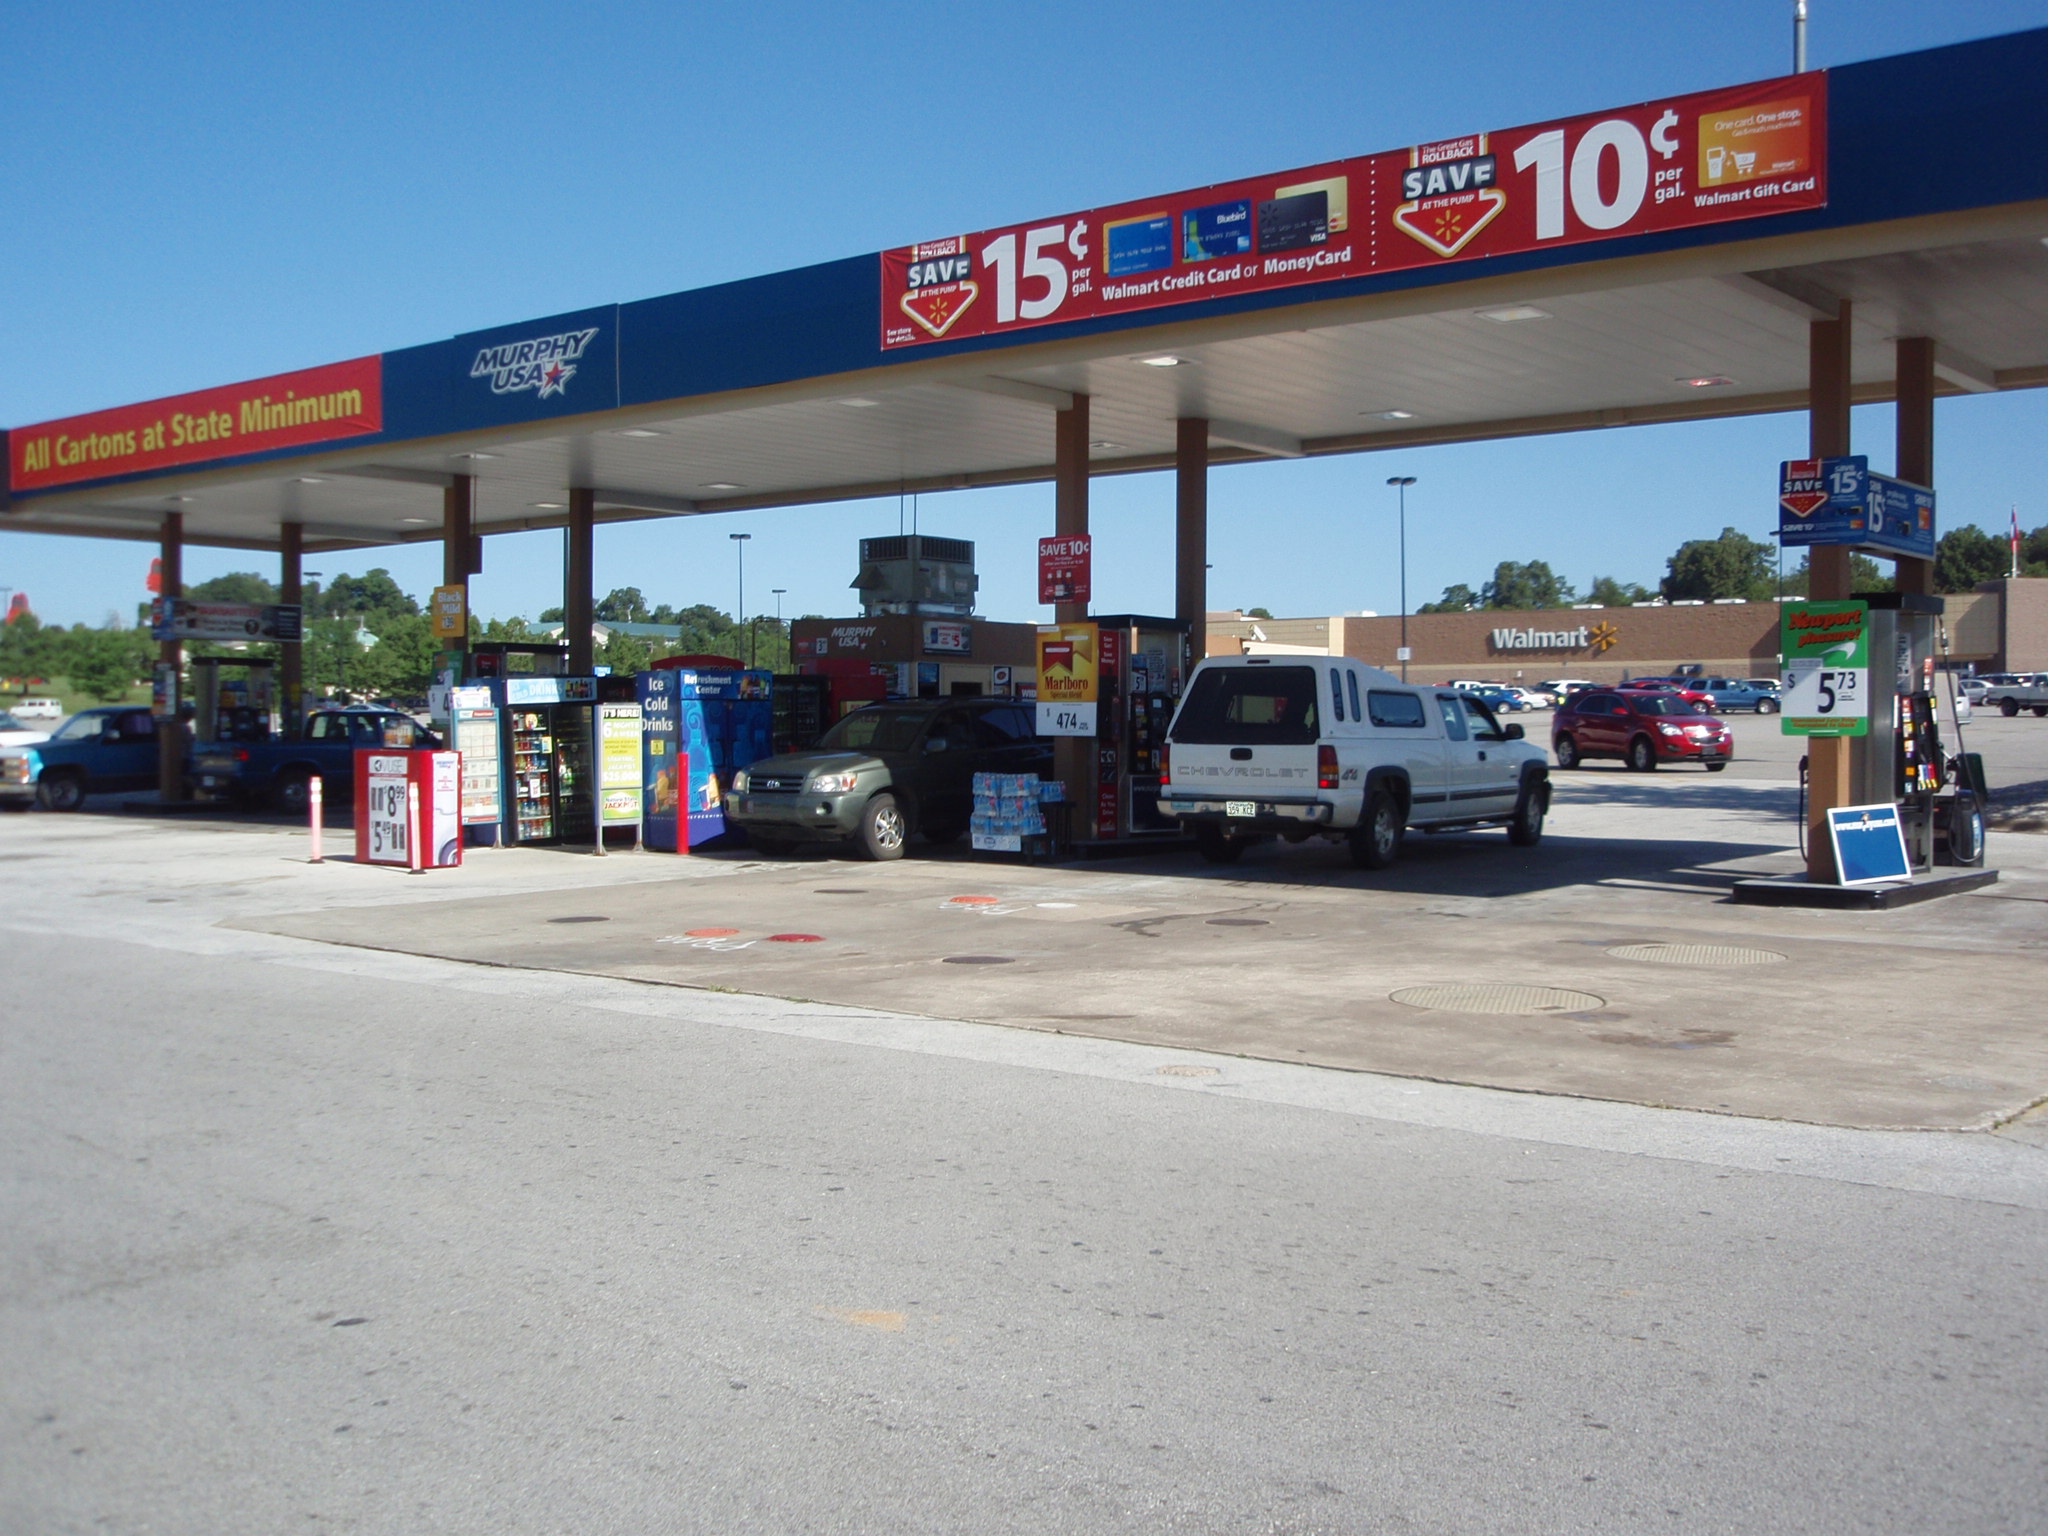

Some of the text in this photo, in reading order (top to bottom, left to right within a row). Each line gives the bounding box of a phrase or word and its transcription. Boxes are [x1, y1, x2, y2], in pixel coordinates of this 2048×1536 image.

[1421, 145, 1475, 165] ROLLBACK
[1405, 162, 1492, 199] SAVE
[1655, 167, 1684, 187] per
[1655, 184, 1686, 204] gal.
[1693, 177, 1816, 208] Walmart Gift Card
[1421, 193, 1475, 211] AT THE PUMP
[1217, 209, 1247, 225] Bluebird
[1309, 232, 1327, 243] VISA
[909, 259, 969, 289] SAVE
[1072, 267, 1091, 281] per
[1102, 244, 1353, 302] Walmart Credit Card or MoneyCard
[920, 284, 957, 298] AT THE PUMP
[1072, 280, 1093, 298] gal.
[471, 327, 600, 378] MURPHY
[491, 362, 545, 394] USA
[24, 387, 363, 474] All Cartons at State Minimum
[1783, 480, 1824, 493] SAVE
[1040, 540, 1090, 557] SAVE 10¢
[1788, 610, 1862, 630] Newport
[831, 626, 876, 637] MURPHY
[1493, 626, 1588, 649] Walmart
[1797, 627, 1862, 648] pleasure!
[838, 637, 859, 647] USA
[648, 678, 664, 691] Ice
[684, 674, 731, 684] Refreshment
[1044, 676, 1089, 690] Marlboro
[1788, 673, 1796, 689] $
[529, 683, 562, 697] DRINKS
[695, 684, 720, 694] Center
[645, 698, 668, 711] Cold
[642, 717, 673, 731] Drinks
[1056, 712, 1077, 729] 474
[603, 722, 612, 738] 6
[1177, 766, 1308, 778] CHEVROLET
[604, 801, 637, 809] JACKPOT
